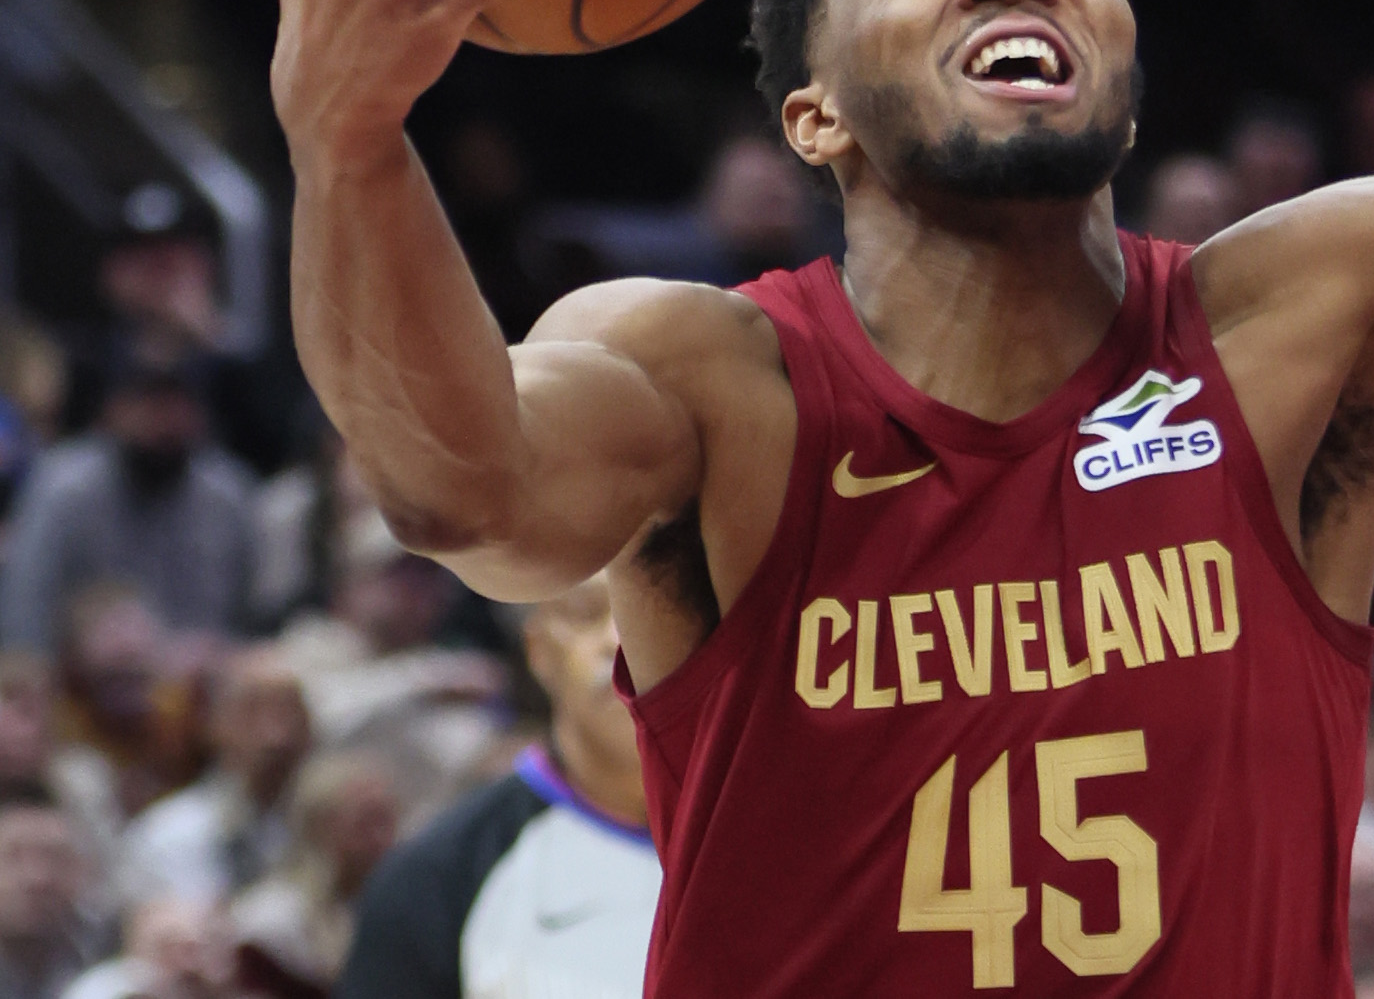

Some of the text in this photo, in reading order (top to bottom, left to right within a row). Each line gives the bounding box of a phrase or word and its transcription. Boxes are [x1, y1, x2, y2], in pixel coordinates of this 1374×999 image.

[1082, 430, 1216, 481] CLIFFS
[794, 539, 1241, 710] CLEVELAND
[897, 729, 1162, 990] 45
